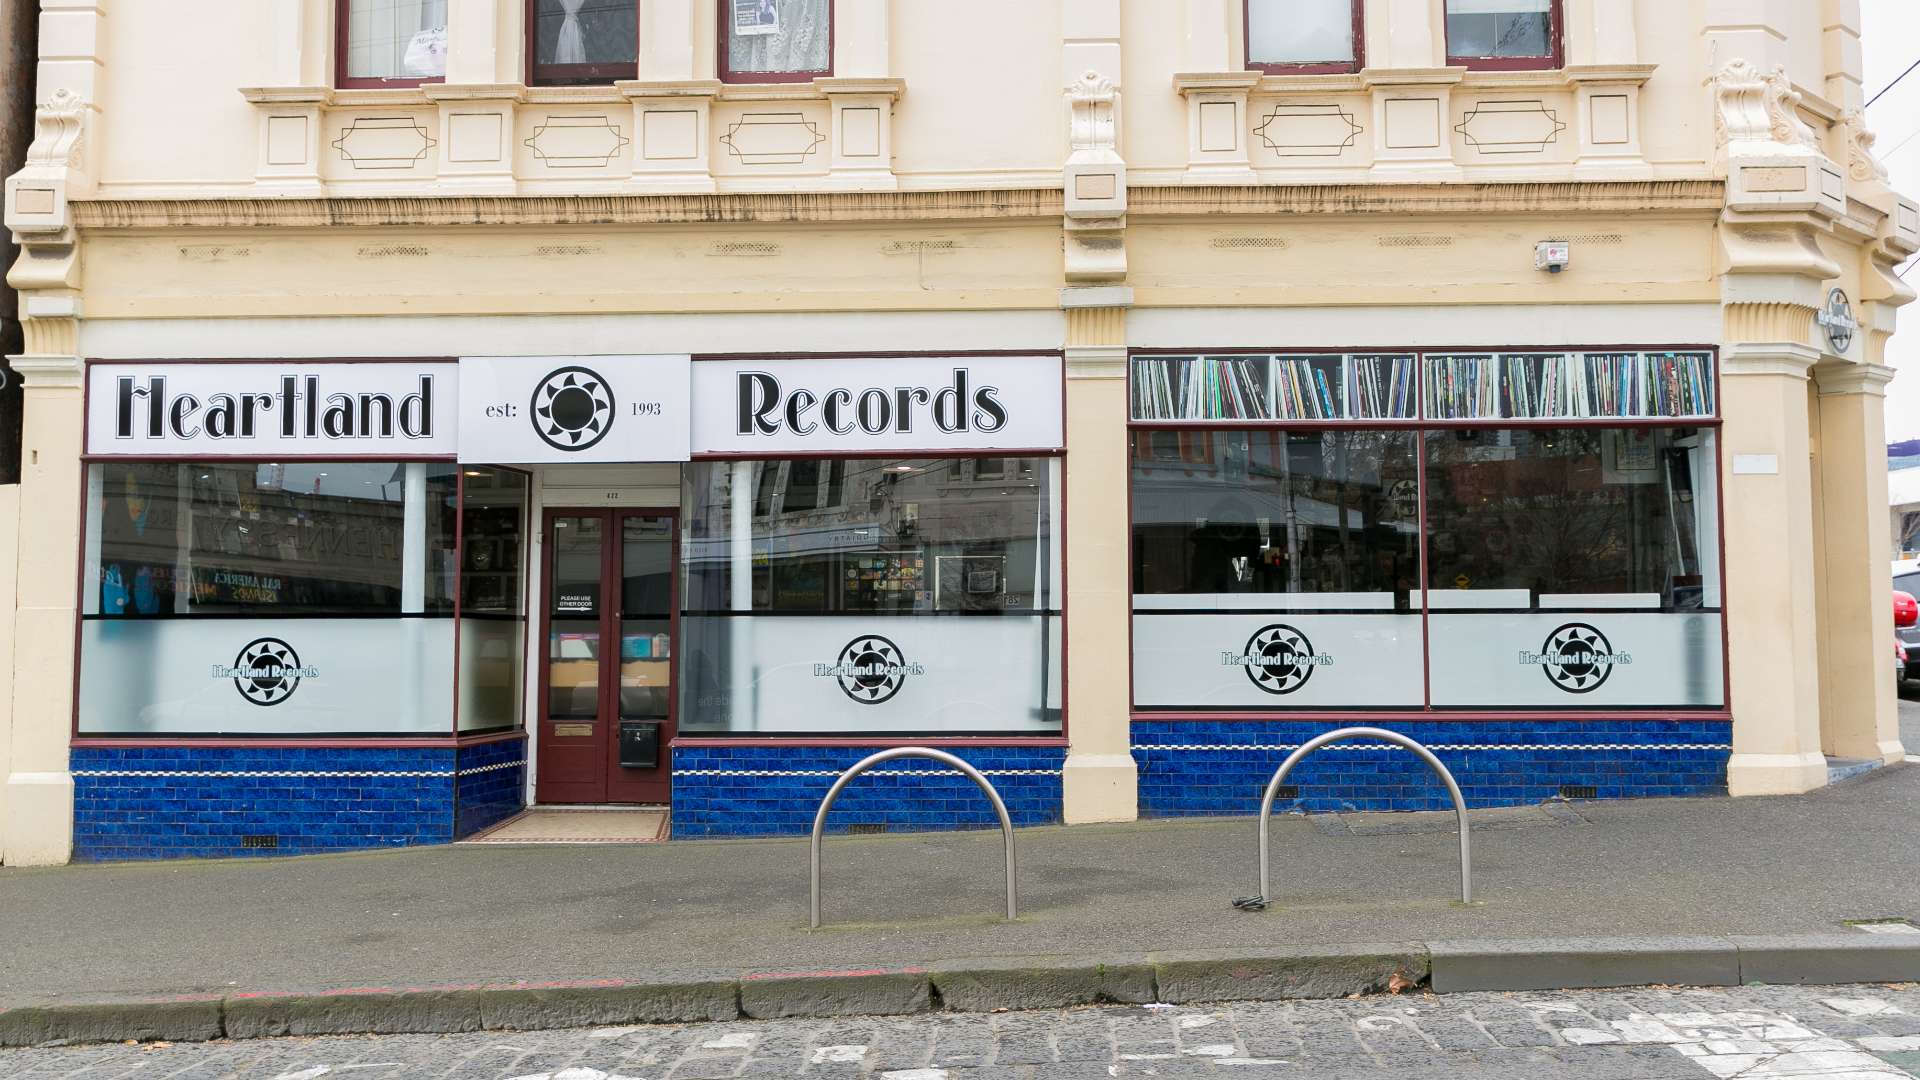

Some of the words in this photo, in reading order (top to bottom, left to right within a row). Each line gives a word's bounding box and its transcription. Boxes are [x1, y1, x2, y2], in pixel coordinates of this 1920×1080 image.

[115, 374, 434, 441] Heartland
[485, 402, 517, 418] est:
[631, 402, 662, 416] 1993
[736, 368, 1008, 436] Records
[1221, 651, 1280, 666] Heartland
[1283, 651, 1334, 665] Records
[1519, 650, 1580, 666] Heartland
[1582, 650, 1632, 664] Records
[212, 664, 270, 679] Heartland
[271, 664, 320, 678] Records
[814, 662, 873, 677] Heartland
[875, 661, 924, 675] Records
